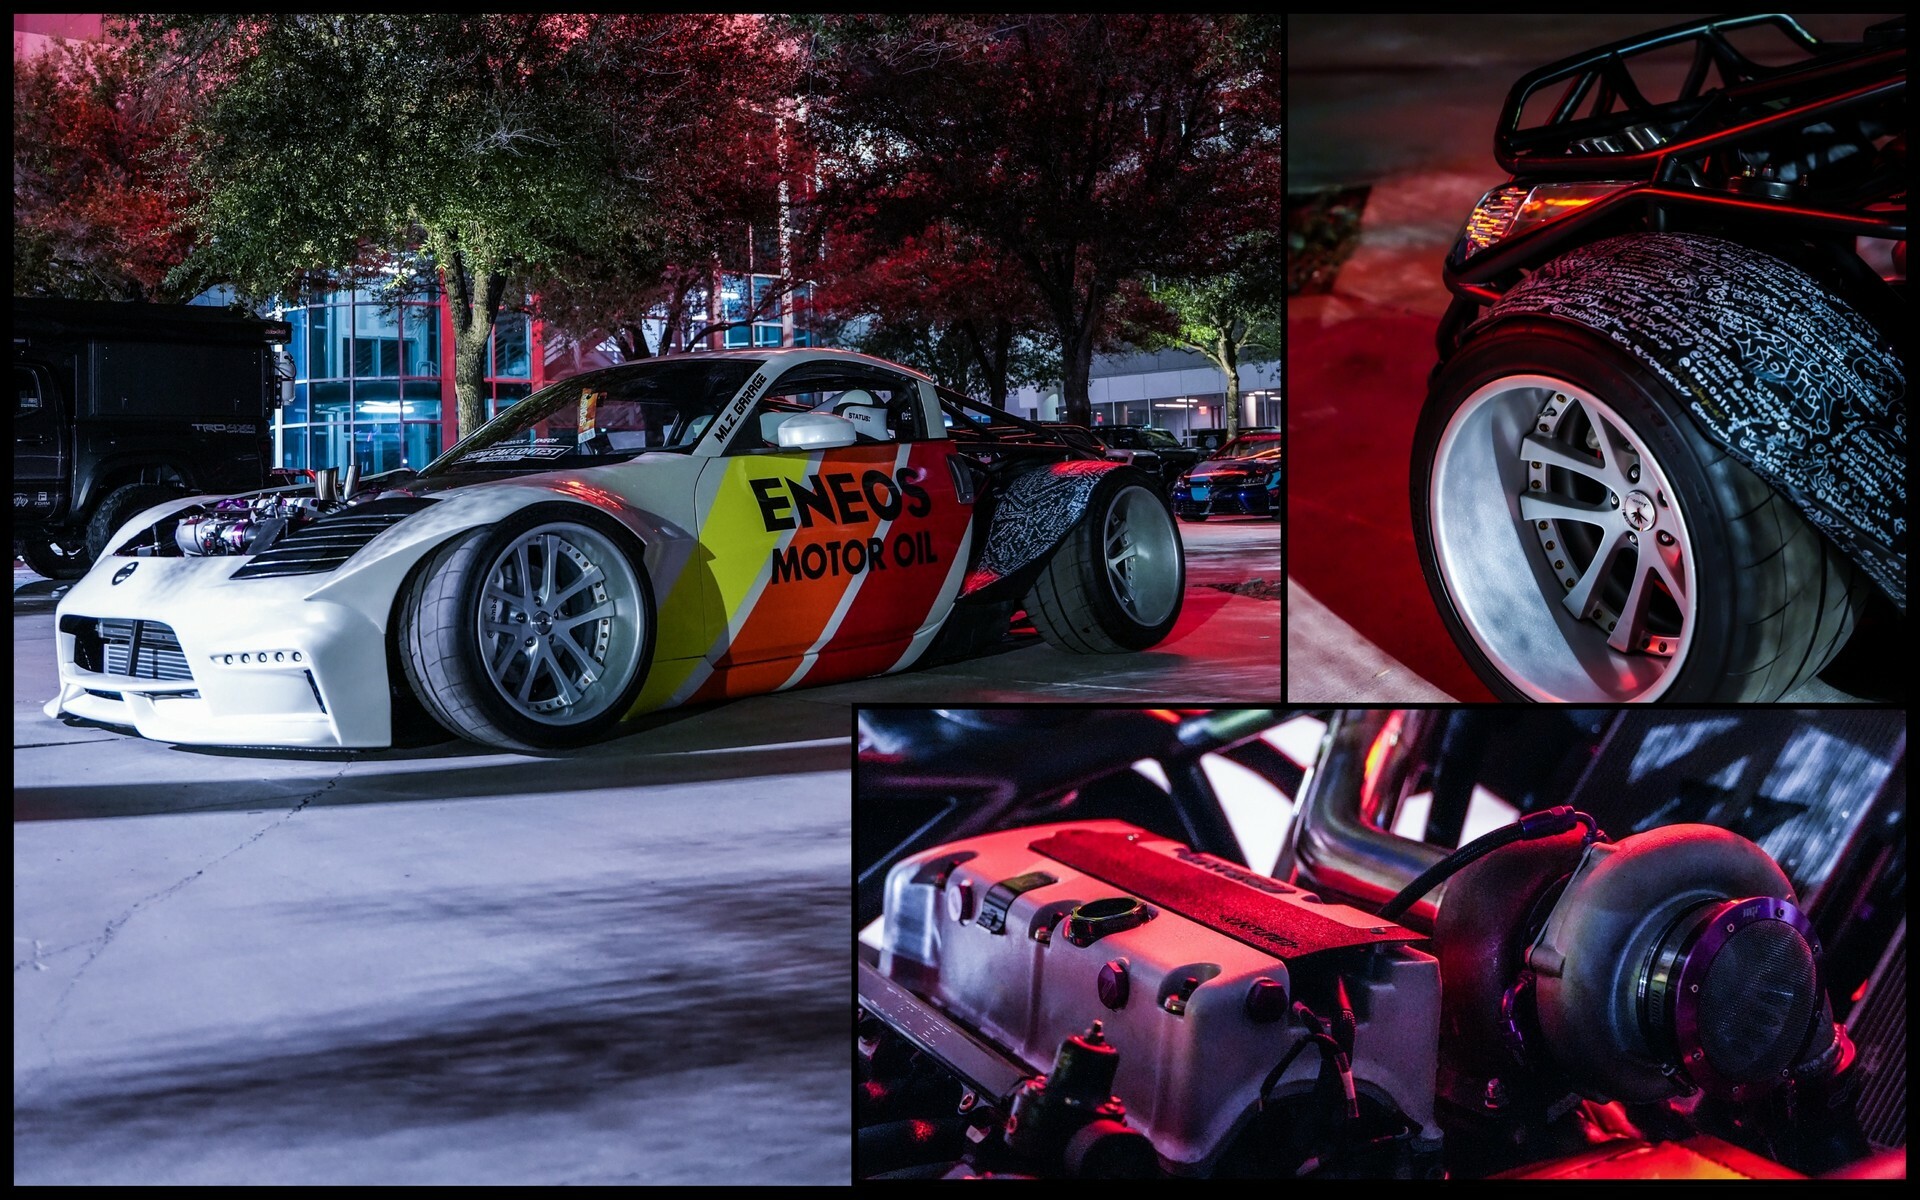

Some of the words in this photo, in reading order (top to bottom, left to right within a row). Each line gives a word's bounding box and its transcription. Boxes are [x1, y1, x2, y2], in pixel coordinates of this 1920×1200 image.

[191, 423, 226, 433] TRD
[749, 467, 931, 532] ENEOS
[772, 537, 887, 585] MOTOR
[893, 531, 938, 568] OIL
